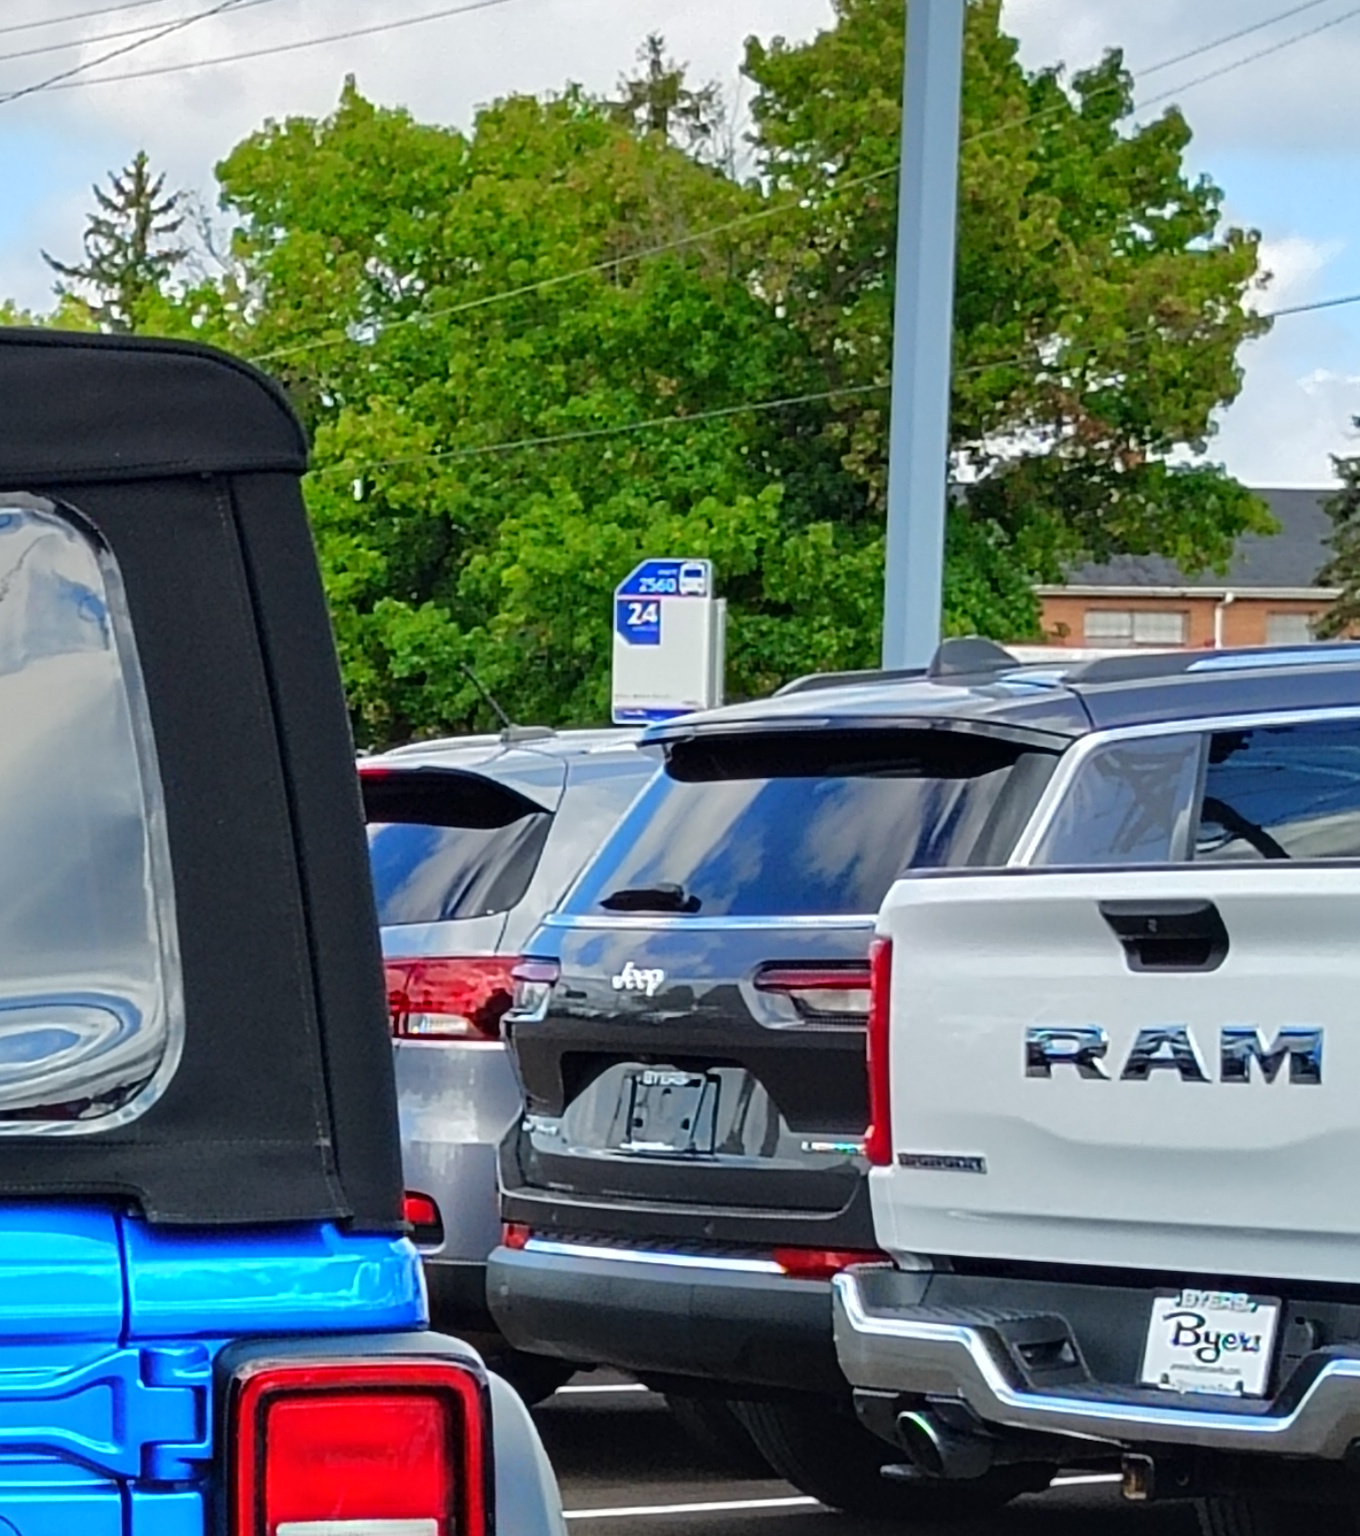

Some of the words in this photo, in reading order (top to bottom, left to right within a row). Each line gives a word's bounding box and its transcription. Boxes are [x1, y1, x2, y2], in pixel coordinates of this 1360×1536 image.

[626, 602, 658, 626] 24
[1023, 1023, 1324, 1085] RAM
[1162, 1310, 1262, 1364] Byers
